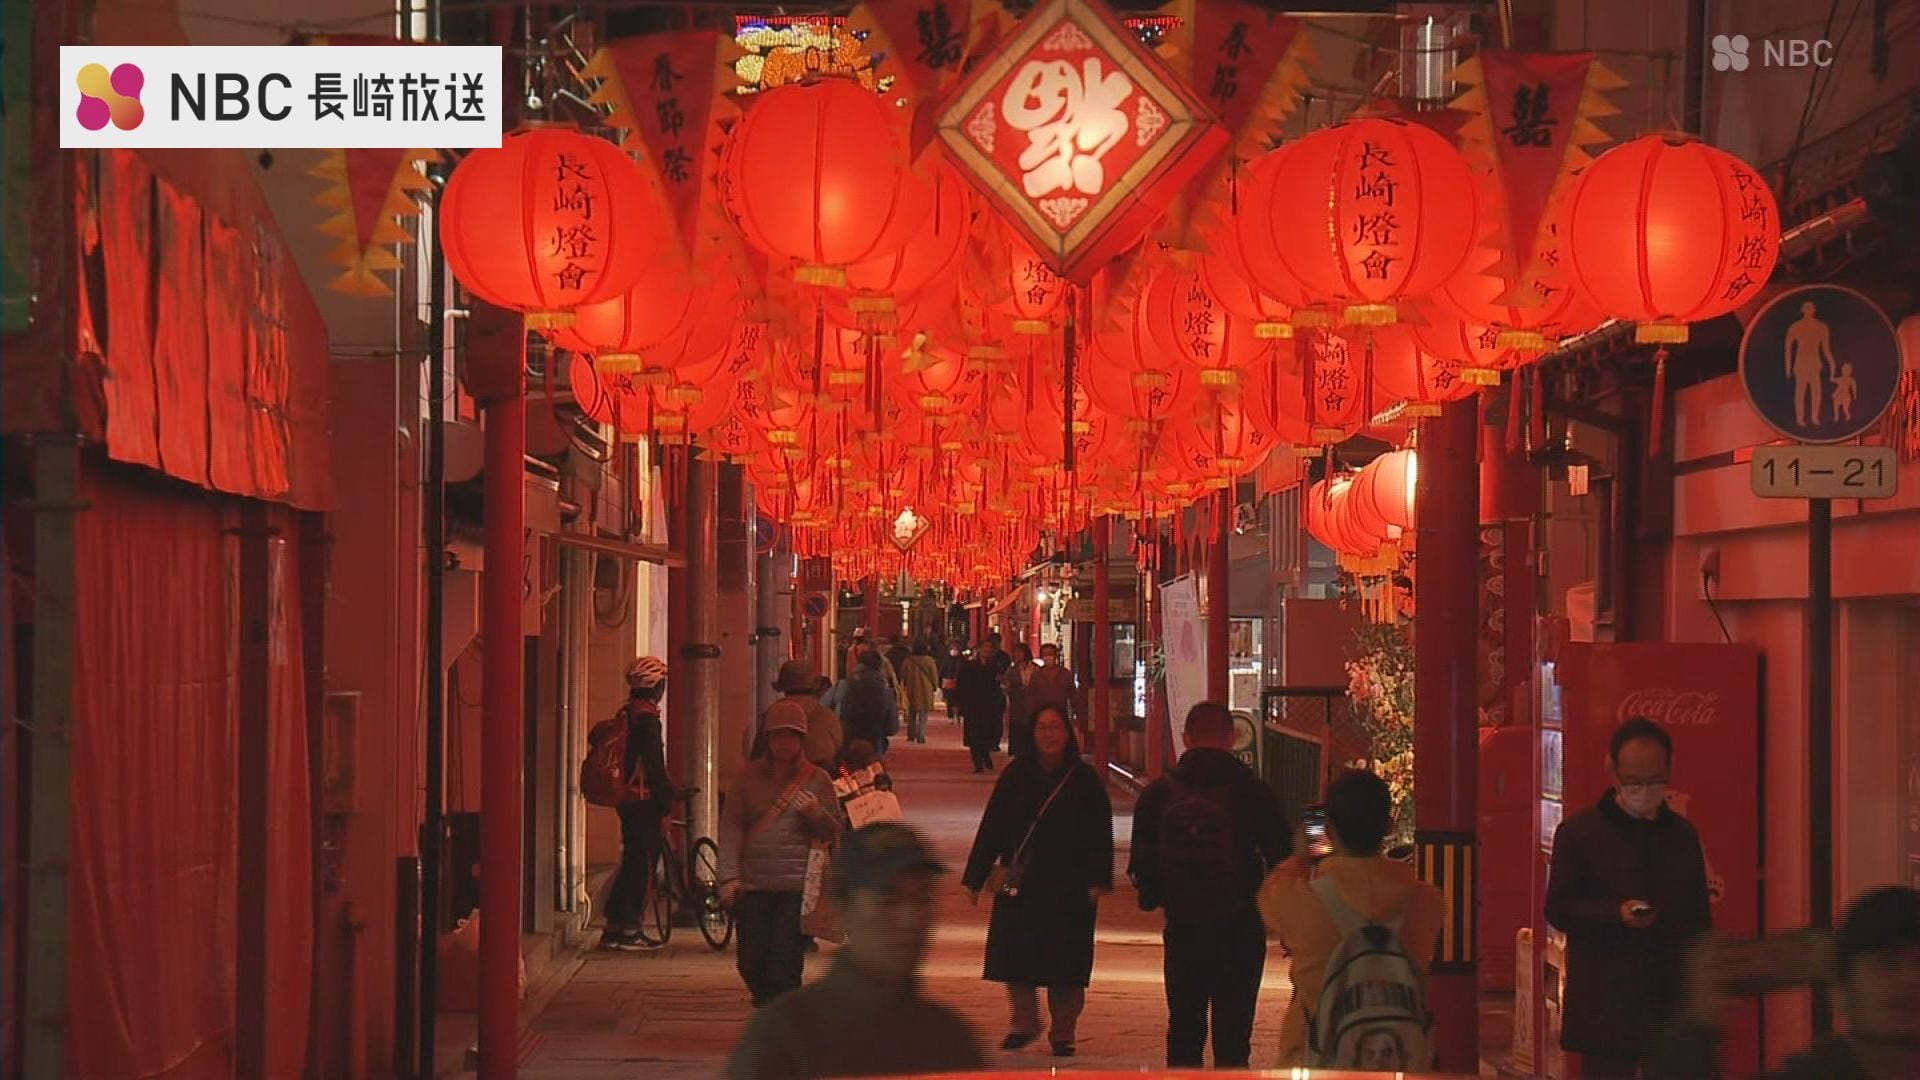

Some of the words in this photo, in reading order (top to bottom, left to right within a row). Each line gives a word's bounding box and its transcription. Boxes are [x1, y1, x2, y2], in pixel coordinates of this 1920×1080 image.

[1209, 21, 1255, 106] 春節
[552, 153, 598, 290] 長崎燈會
[1353, 142, 1402, 280] 長崎燈會
[1720, 164, 1768, 301] 長崎燈會
[1183, 272, 1217, 358] 崎燈會
[1763, 457, 1883, 487] 11-21
